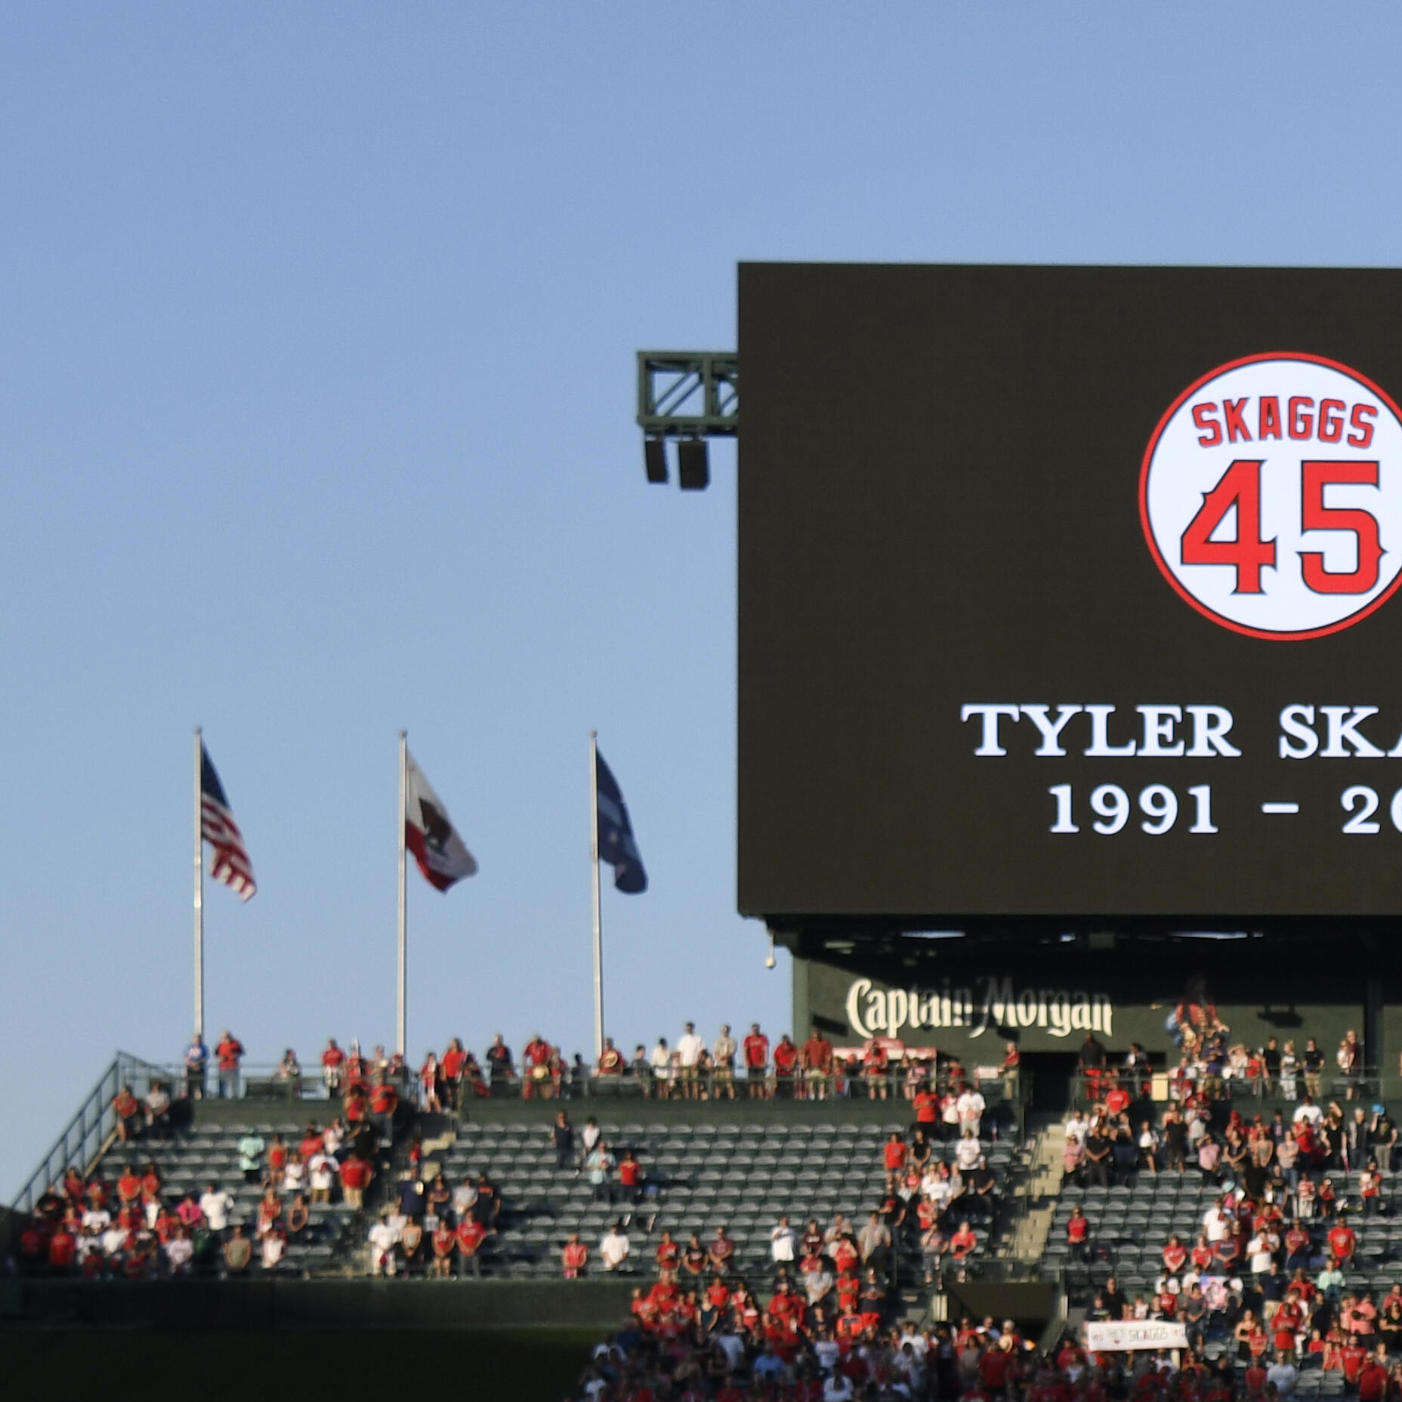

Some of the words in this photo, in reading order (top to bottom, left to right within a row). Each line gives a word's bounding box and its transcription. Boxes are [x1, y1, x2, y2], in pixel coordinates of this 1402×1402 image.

[1192, 395, 1379, 449] SKAGGS
[1180, 459, 1388, 595] 45
[961, 704, 1241, 758] TYLER
[1048, 785, 1219, 835] 1991
[845, 977, 973, 1039] Captain
[969, 974, 1113, 1039] Morgan
